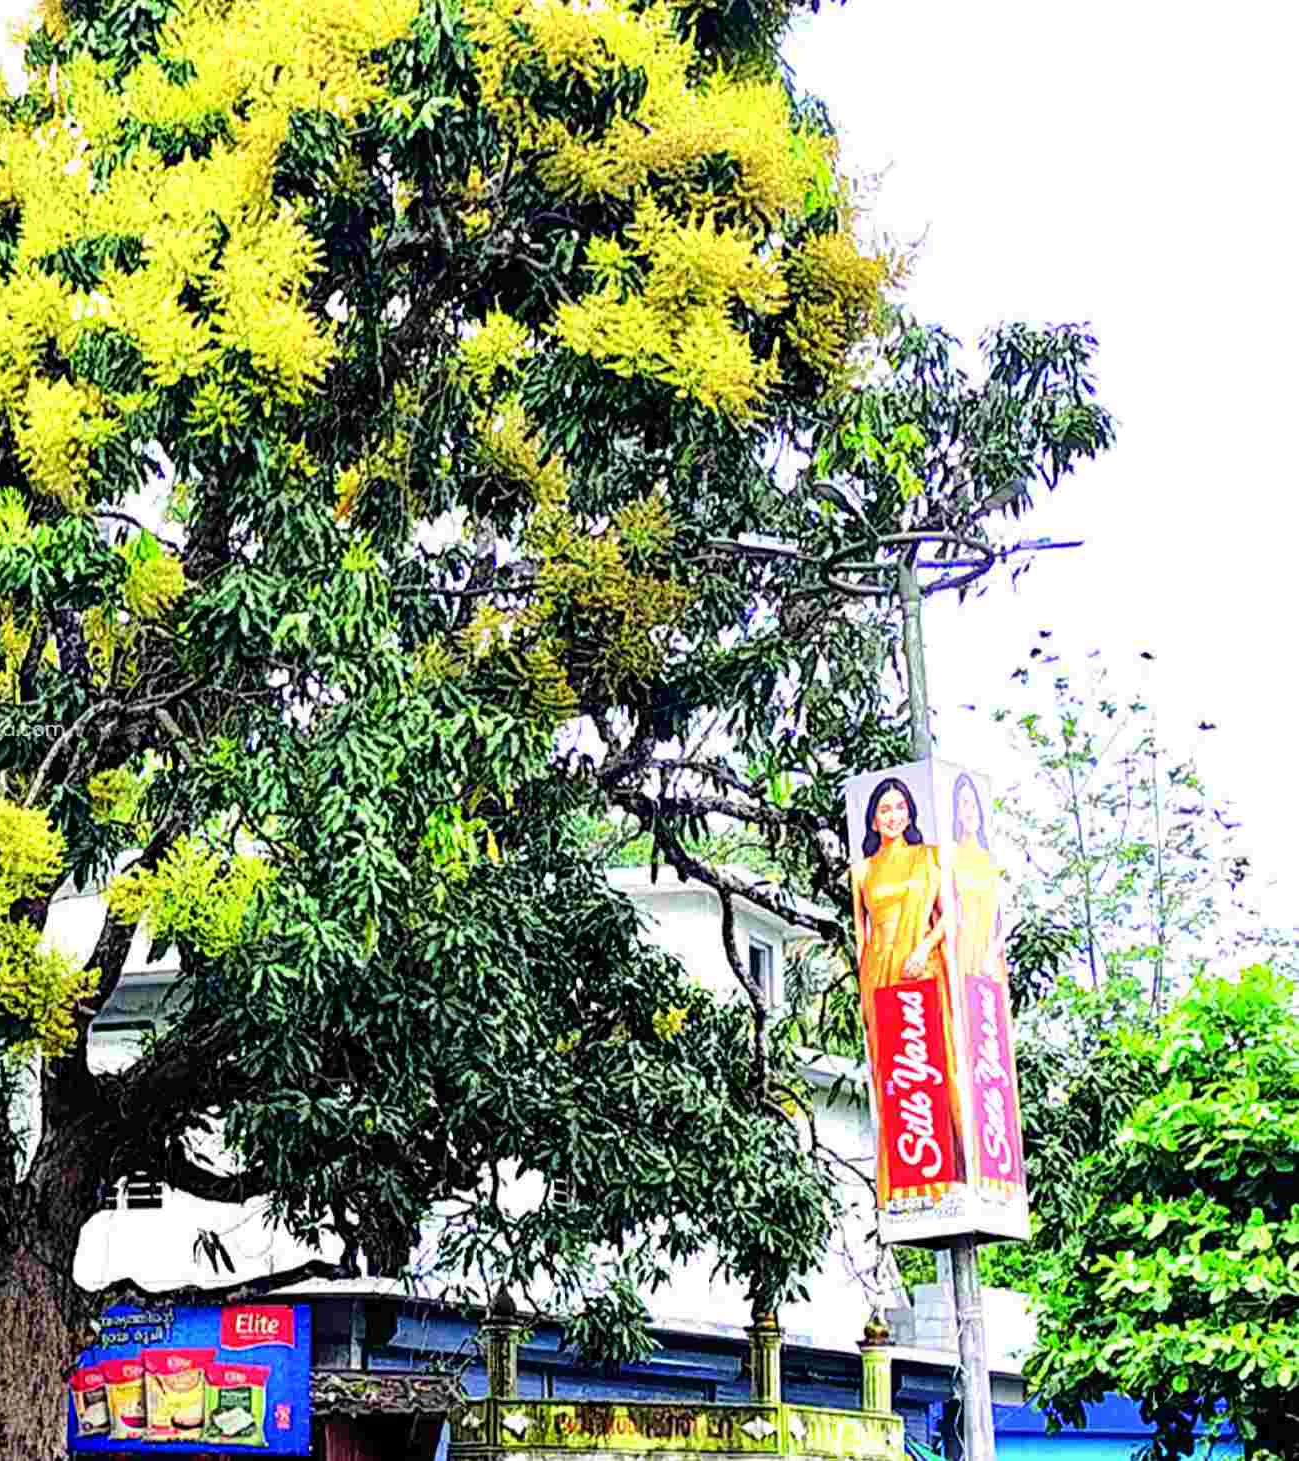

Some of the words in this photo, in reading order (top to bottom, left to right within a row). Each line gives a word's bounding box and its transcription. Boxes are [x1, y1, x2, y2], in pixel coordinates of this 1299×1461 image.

[892, 991, 944, 1090] Yarns
[897, 1090, 943, 1178] Silk
[234, 1313, 280, 1335] Elite
